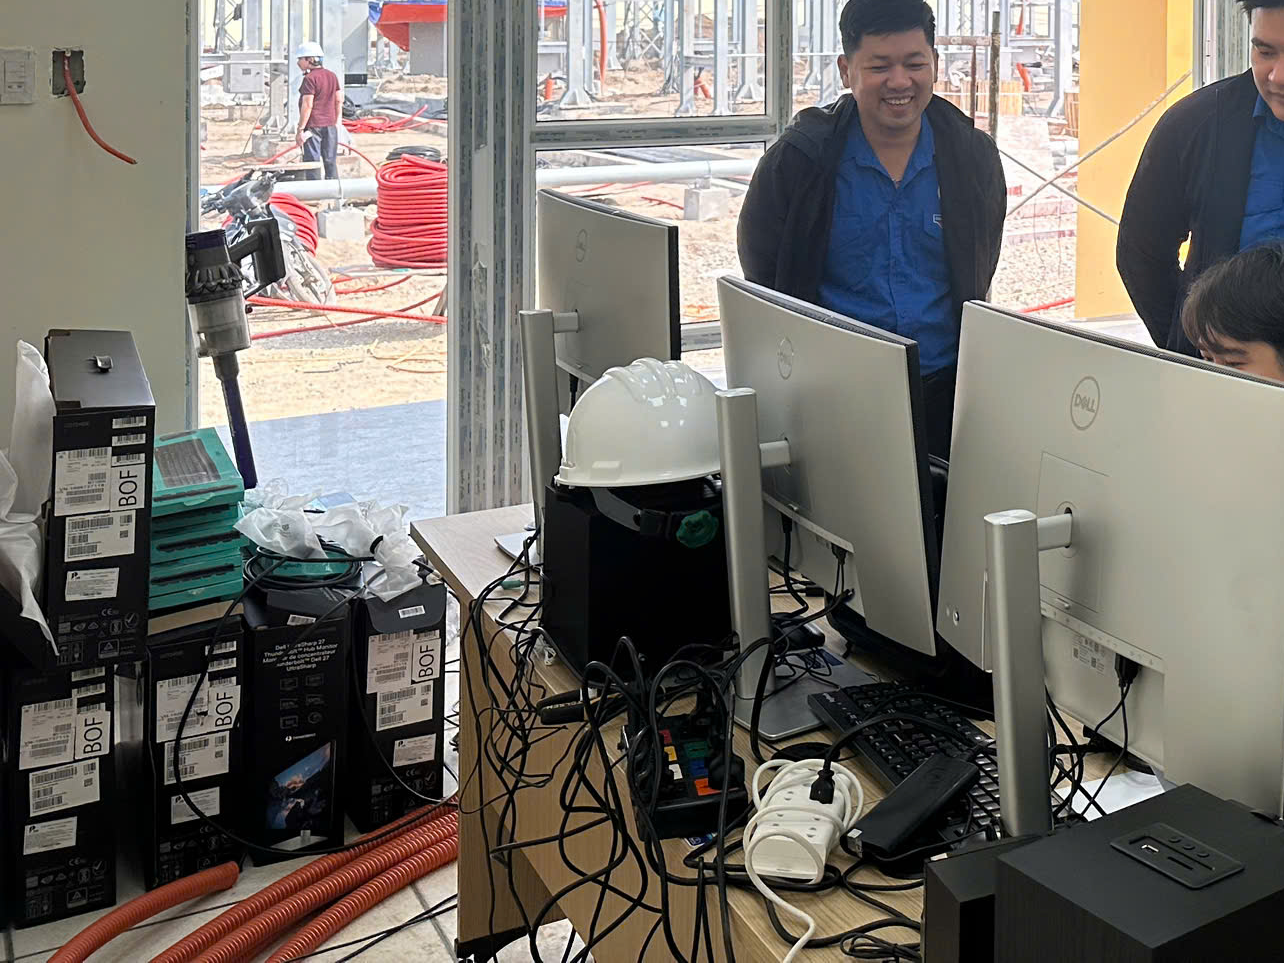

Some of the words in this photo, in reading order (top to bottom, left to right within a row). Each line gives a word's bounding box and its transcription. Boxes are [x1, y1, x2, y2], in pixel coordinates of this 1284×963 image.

[1074, 393, 1096, 413] DELL
[118, 470, 138, 507] BOF
[418, 644, 435, 678] BOF
[215, 691, 234, 728] BOF
[83, 716, 103, 755] BOF
